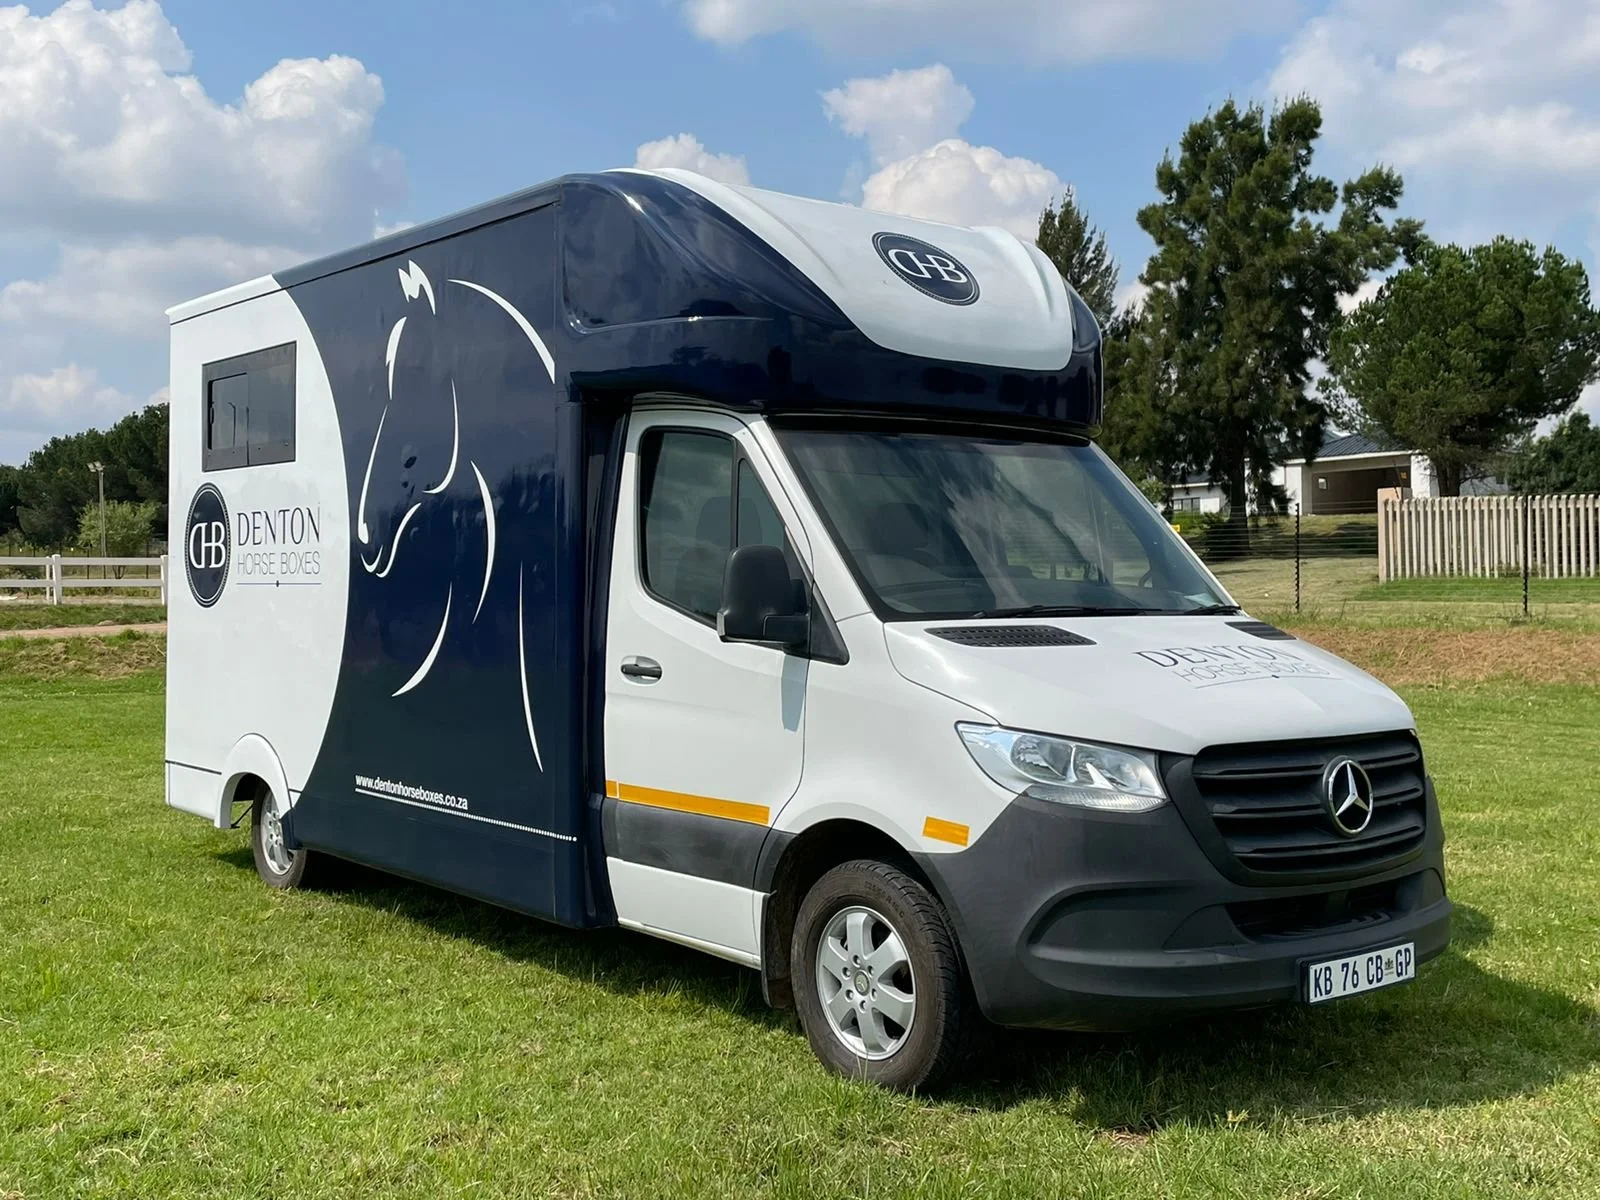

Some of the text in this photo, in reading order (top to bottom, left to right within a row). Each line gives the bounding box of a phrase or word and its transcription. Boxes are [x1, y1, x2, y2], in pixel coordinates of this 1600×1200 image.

[237, 506, 321, 546] DENTON
[237, 550, 321, 575] HORSE BOXES
[1133, 645, 1305, 668] DENTON
[1173, 661, 1331, 683] HORSE BOXES
[355, 774, 468, 811] www.dentonhorseboxes.co.za
[1314, 947, 1411, 998] KB 76 CB GP
